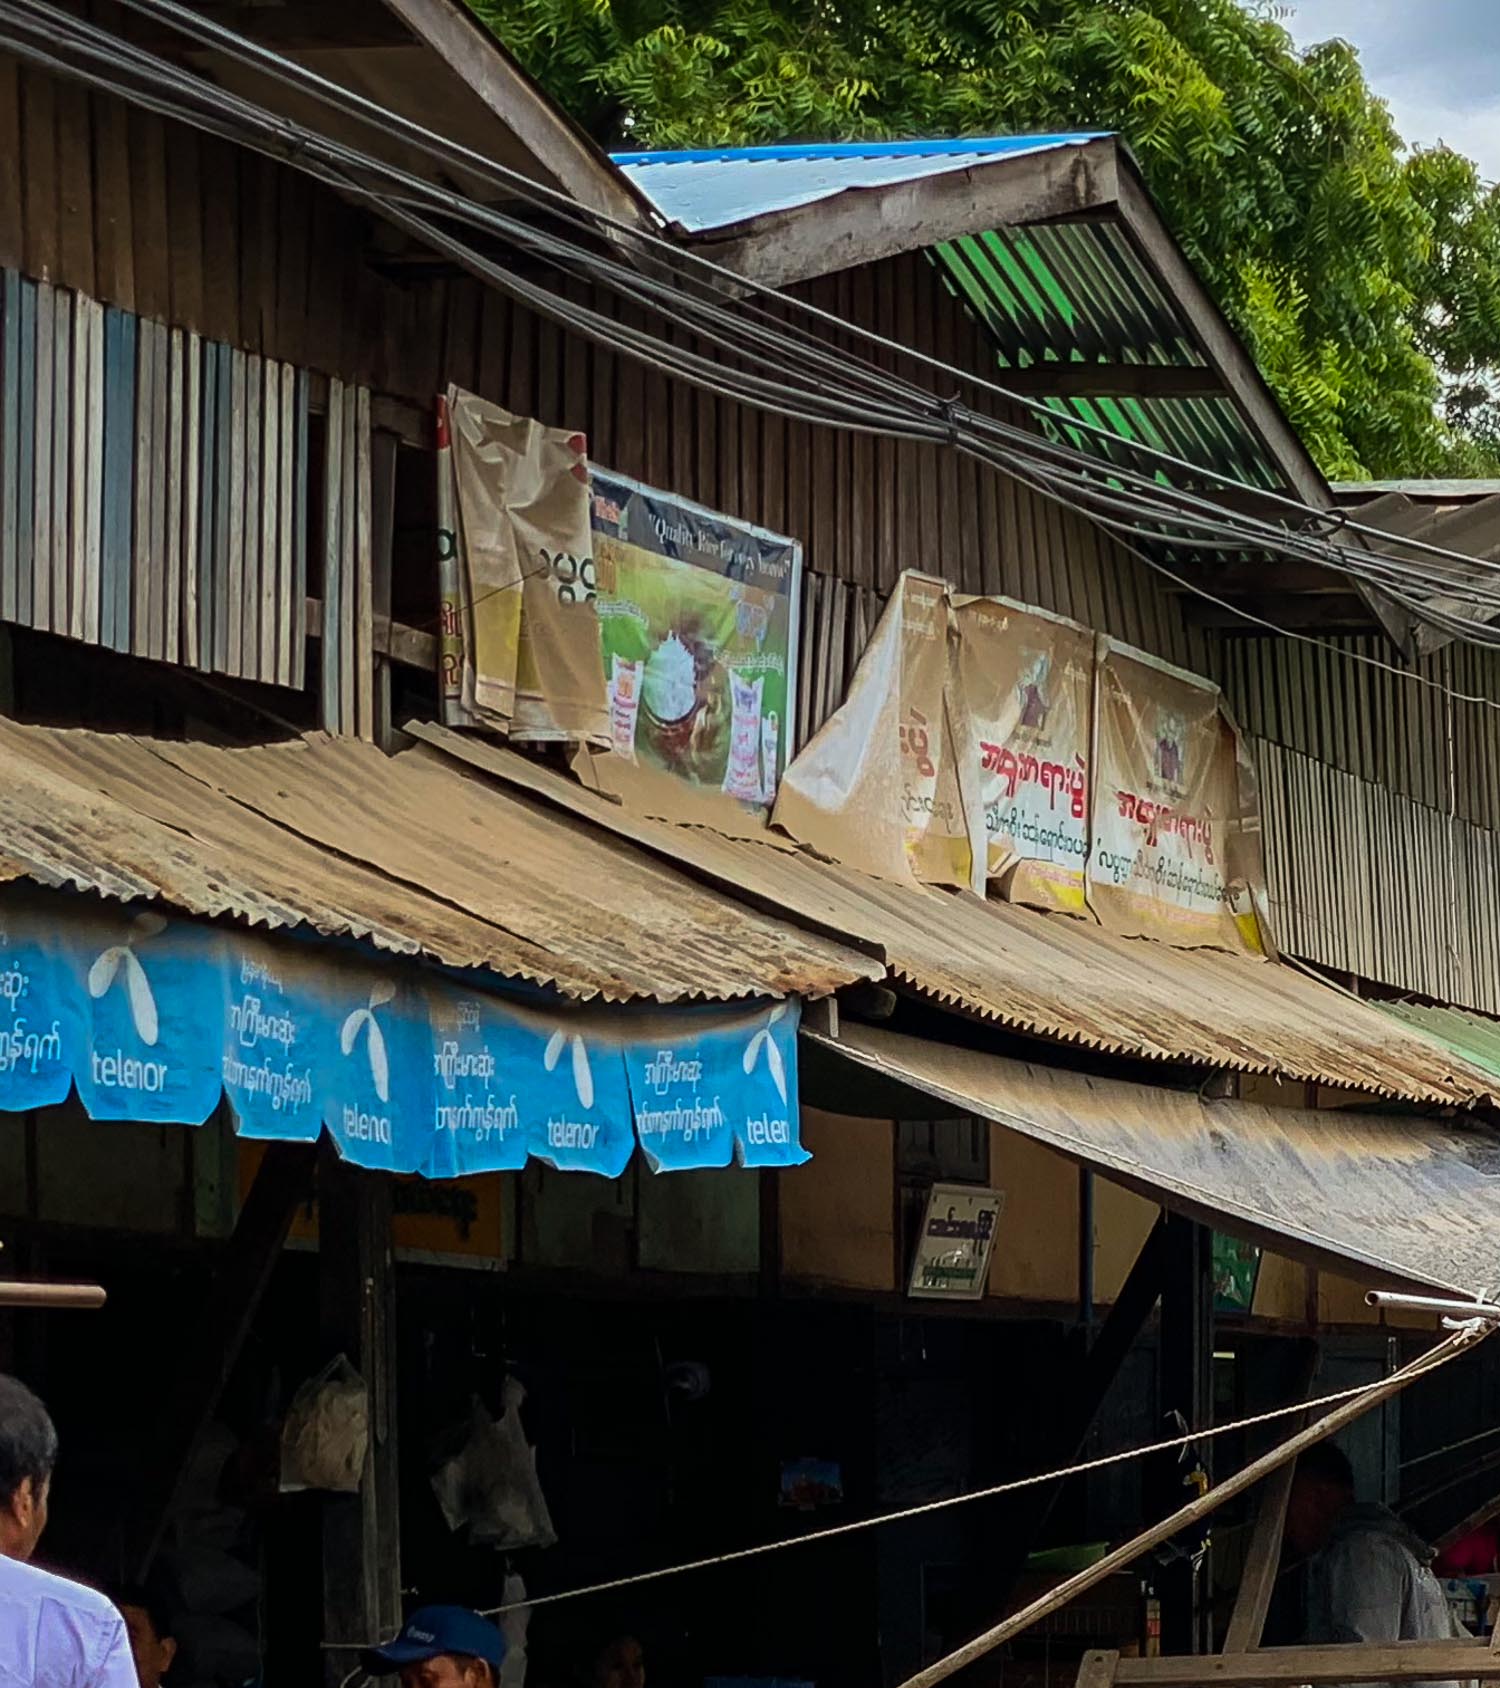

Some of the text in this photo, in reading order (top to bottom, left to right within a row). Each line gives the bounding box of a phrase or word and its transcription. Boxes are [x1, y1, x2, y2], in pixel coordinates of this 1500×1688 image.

[92, 1048, 168, 1092] telenor
[548, 1114, 599, 1149] telenor
[746, 1112, 790, 1145] telen
